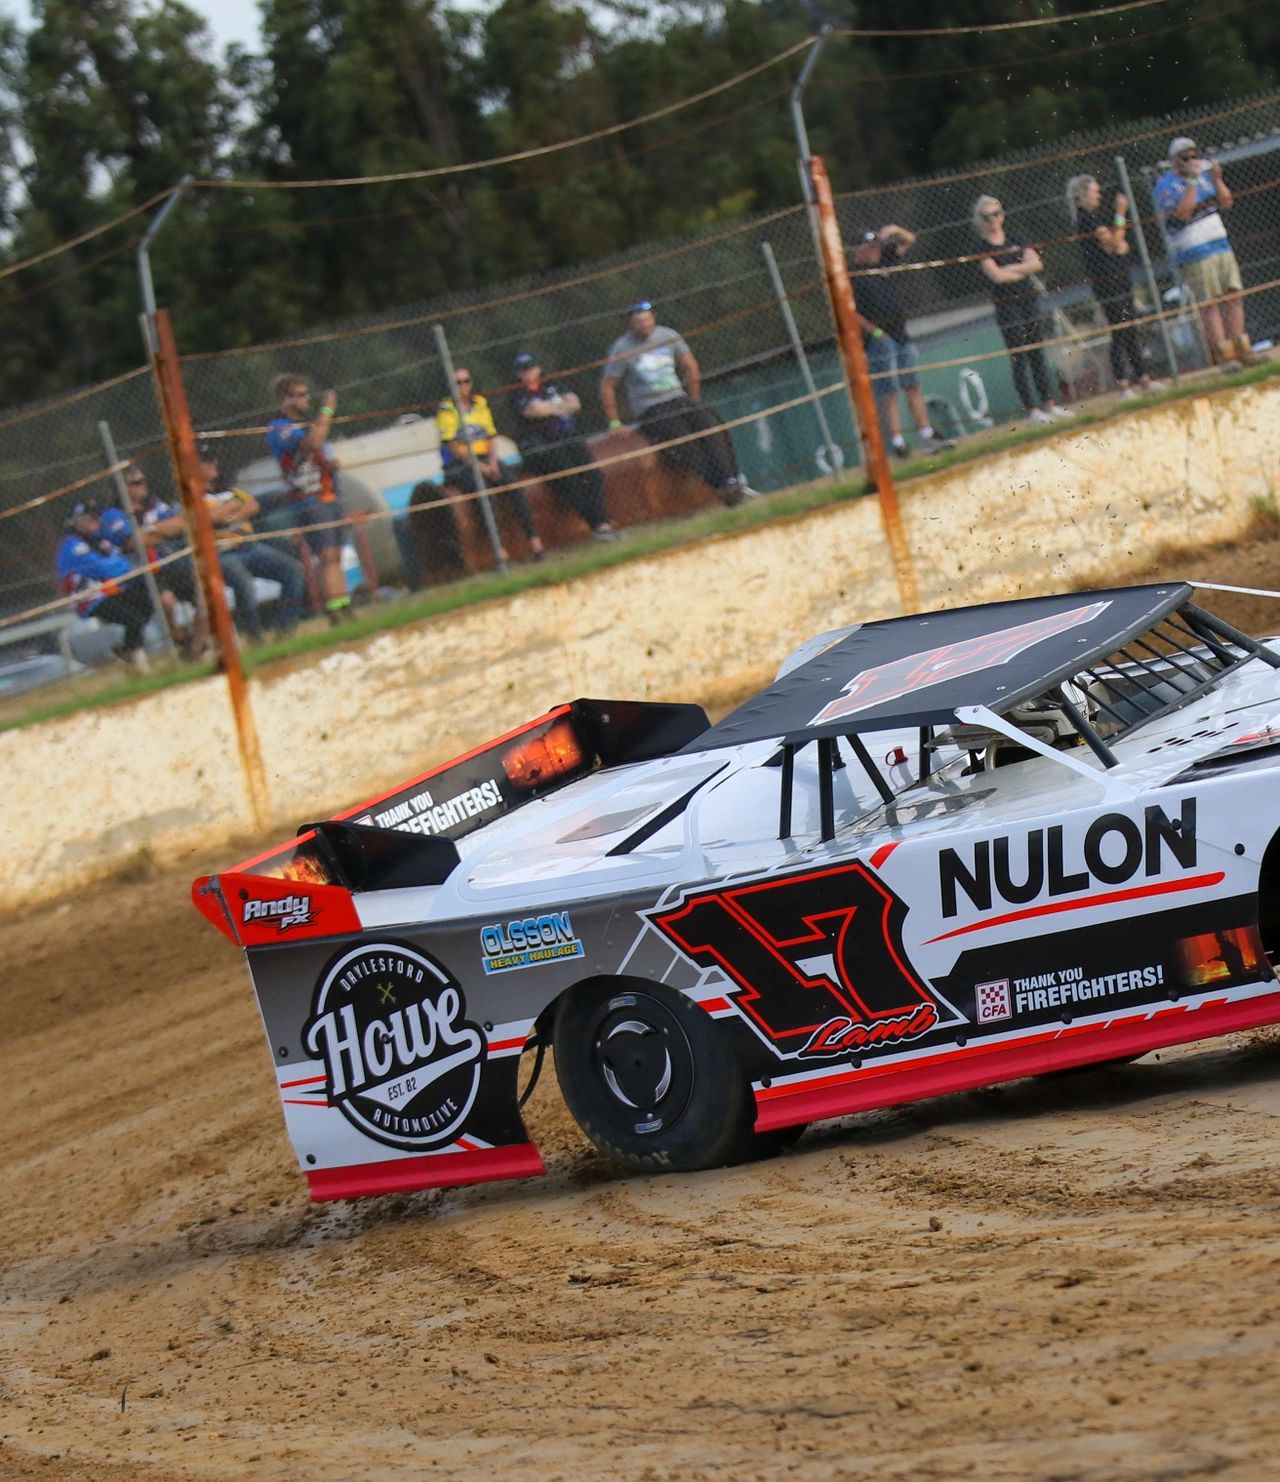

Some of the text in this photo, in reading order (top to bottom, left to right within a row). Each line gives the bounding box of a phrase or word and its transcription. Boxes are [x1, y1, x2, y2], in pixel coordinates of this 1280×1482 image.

[374, 790, 434, 828] THANK YOU
[939, 797, 1197, 919] NULON
[244, 895, 310, 922] Andy
[480, 910, 575, 956] OLSSON
[650, 860, 934, 1043] 17
[339, 957, 425, 992] DAYLESFORD
[490, 944, 578, 970] HEAVY HAULAGE
[1013, 967, 1084, 993] THANK YOU
[1016, 965, 1165, 1014] FIREFIGHTERS!
[803, 1003, 938, 1056] Lamb
[982, 1005, 1007, 1018] CFA
[308, 987, 482, 1098] Howe
[388, 1082, 404, 1101] EST.
[373, 1097, 458, 1133] AUTOMOTIVE
